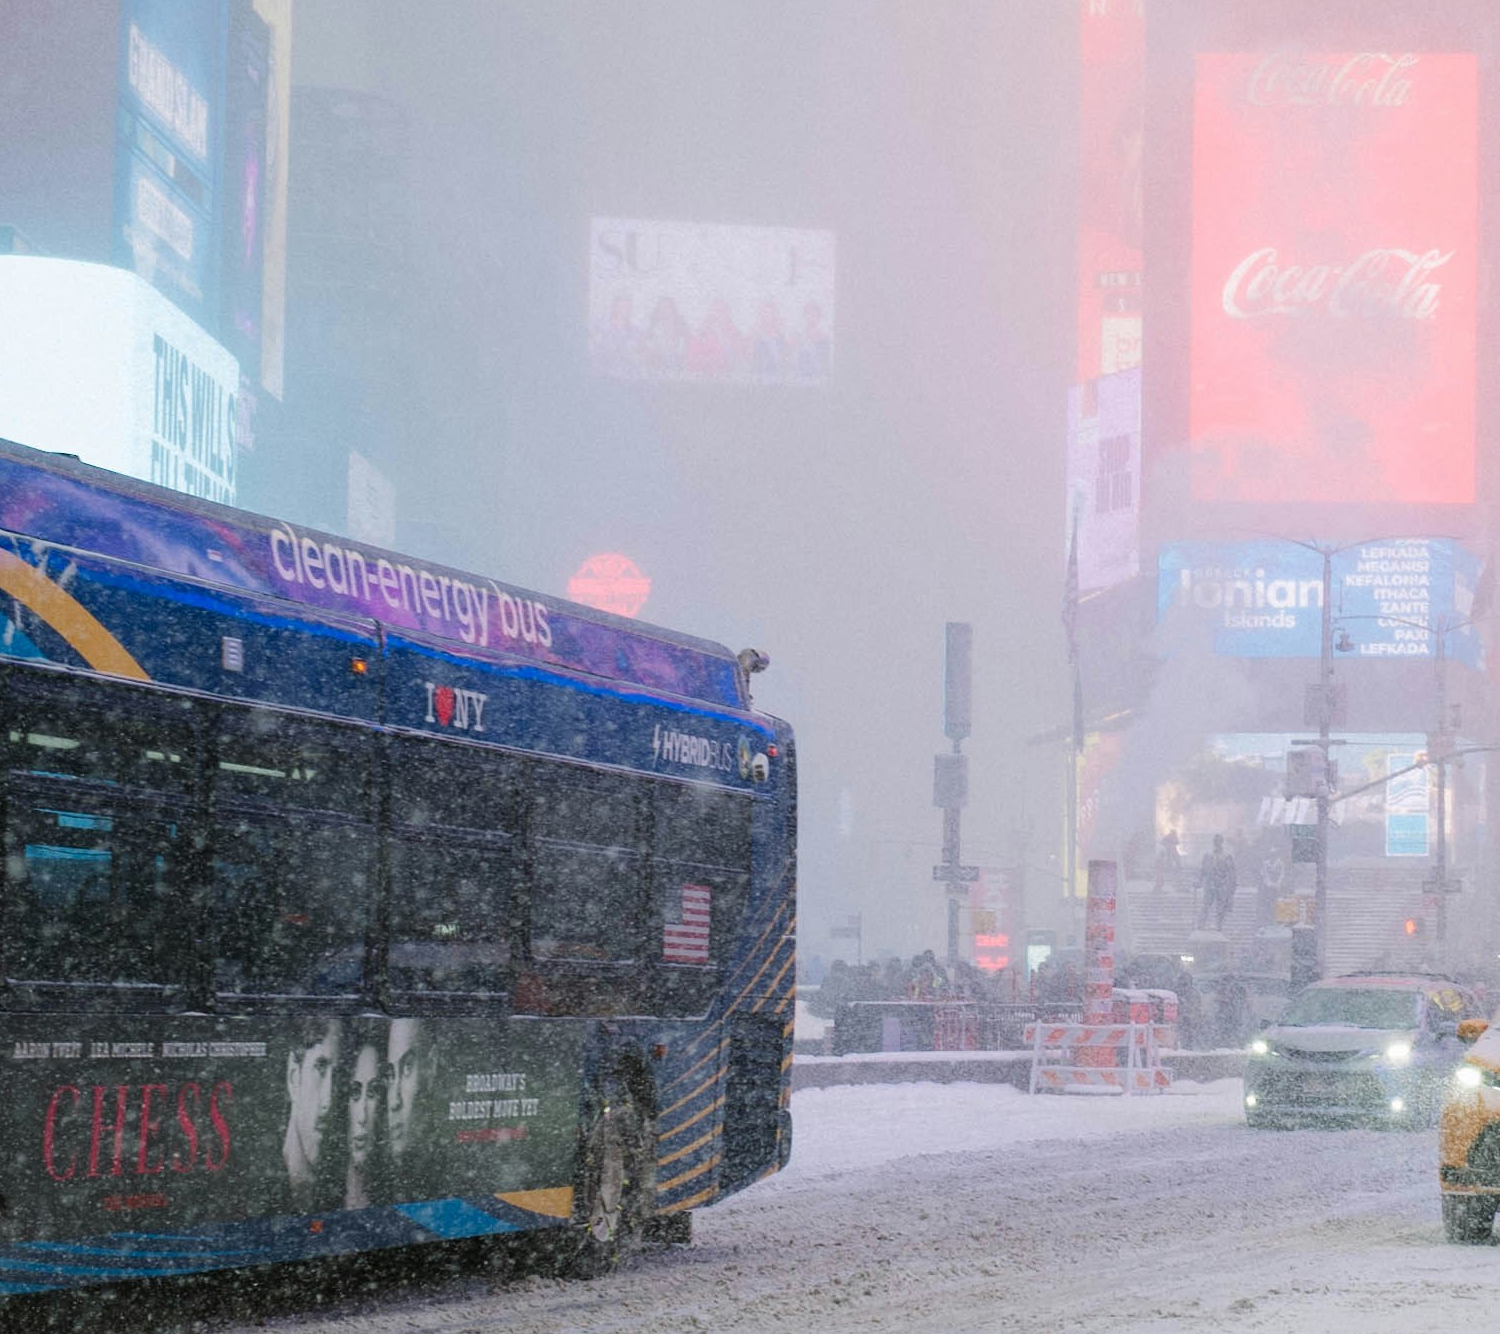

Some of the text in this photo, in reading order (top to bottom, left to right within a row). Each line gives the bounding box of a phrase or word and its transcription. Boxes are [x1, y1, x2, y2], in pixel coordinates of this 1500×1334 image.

[1221, 246, 1457, 320] Coca-Cola
[269, 521, 553, 649] clean-energy bus
[1179, 566, 1326, 610] Ionian
[1223, 611, 1298, 630] Islands
[41, 1080, 234, 1182] CHESS
